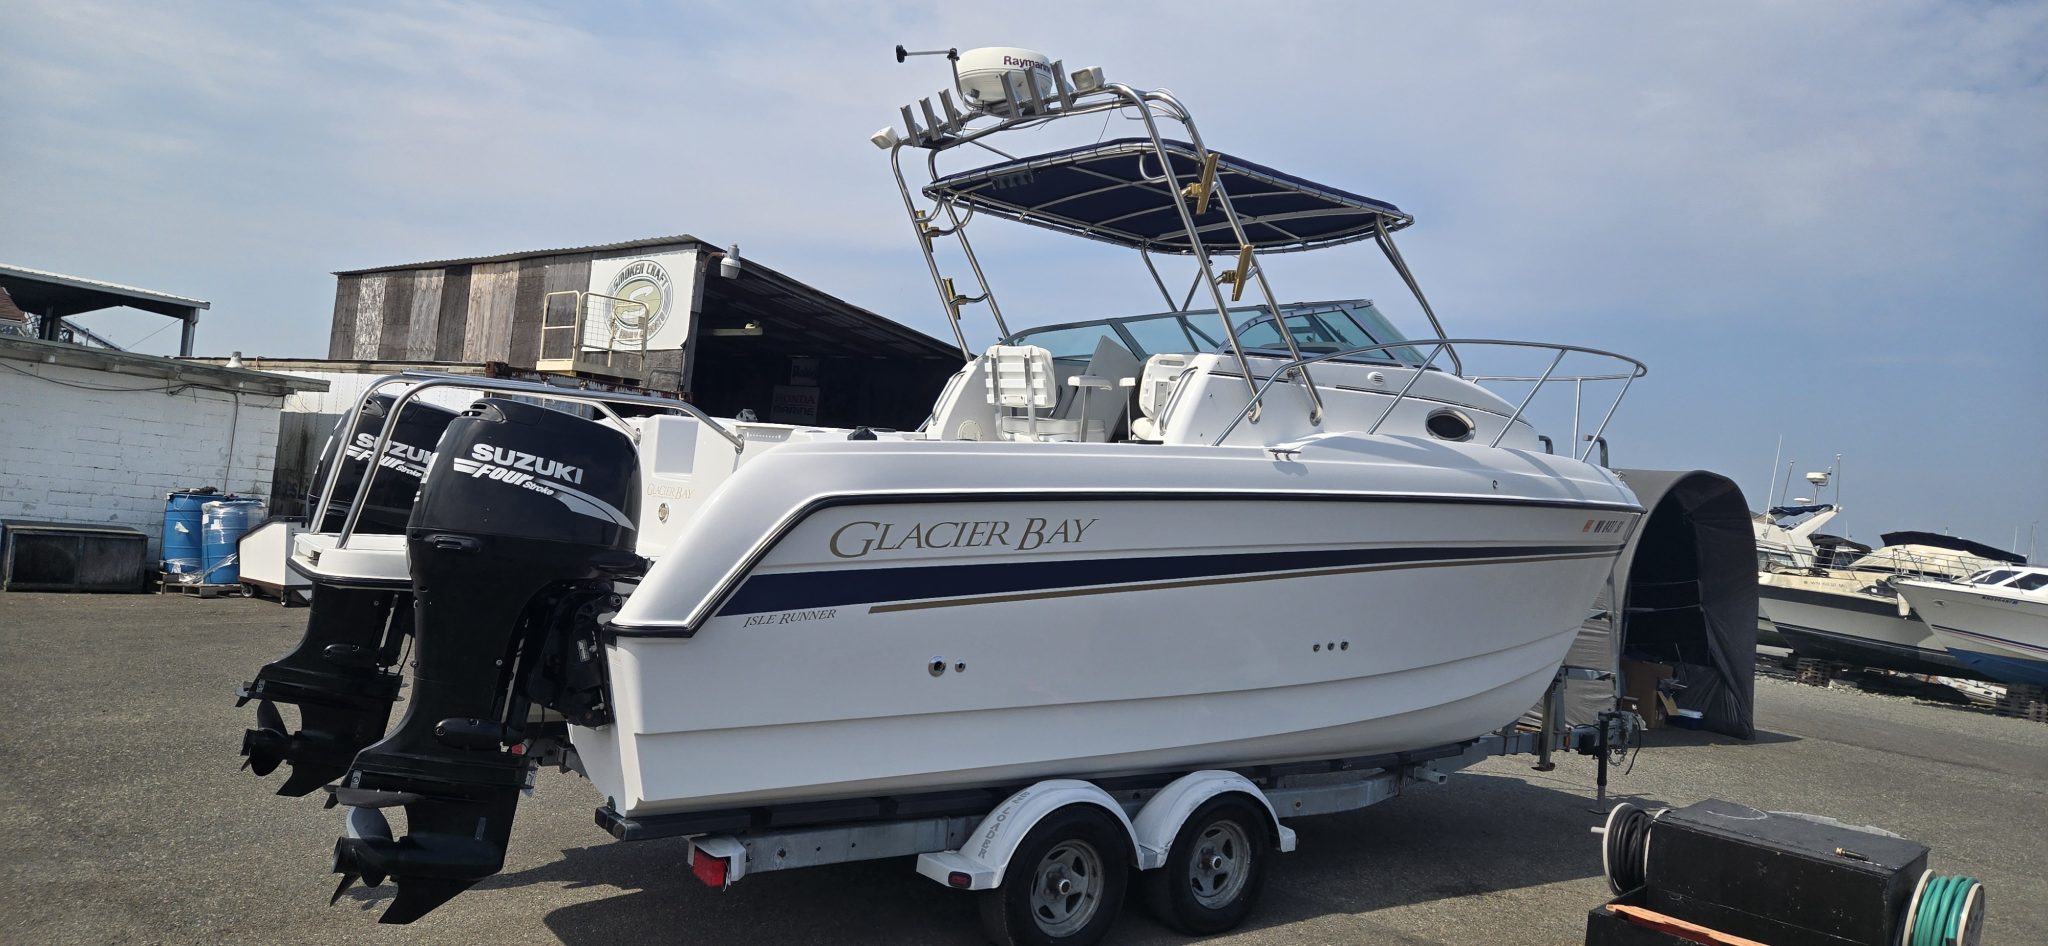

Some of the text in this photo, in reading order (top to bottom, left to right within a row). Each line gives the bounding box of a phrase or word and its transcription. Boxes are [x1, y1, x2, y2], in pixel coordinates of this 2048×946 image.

[613, 262, 670, 292] SMOKER CRAFT
[356, 433, 435, 464] SUZUK
[471, 443, 584, 485] SUZUKI
[522, 481, 555, 496] Stroke
[829, 517, 1099, 559] GLACIER BAY
[743, 608, 837, 628] ISLE RUNNER
[977, 806, 1011, 860] LOADER
